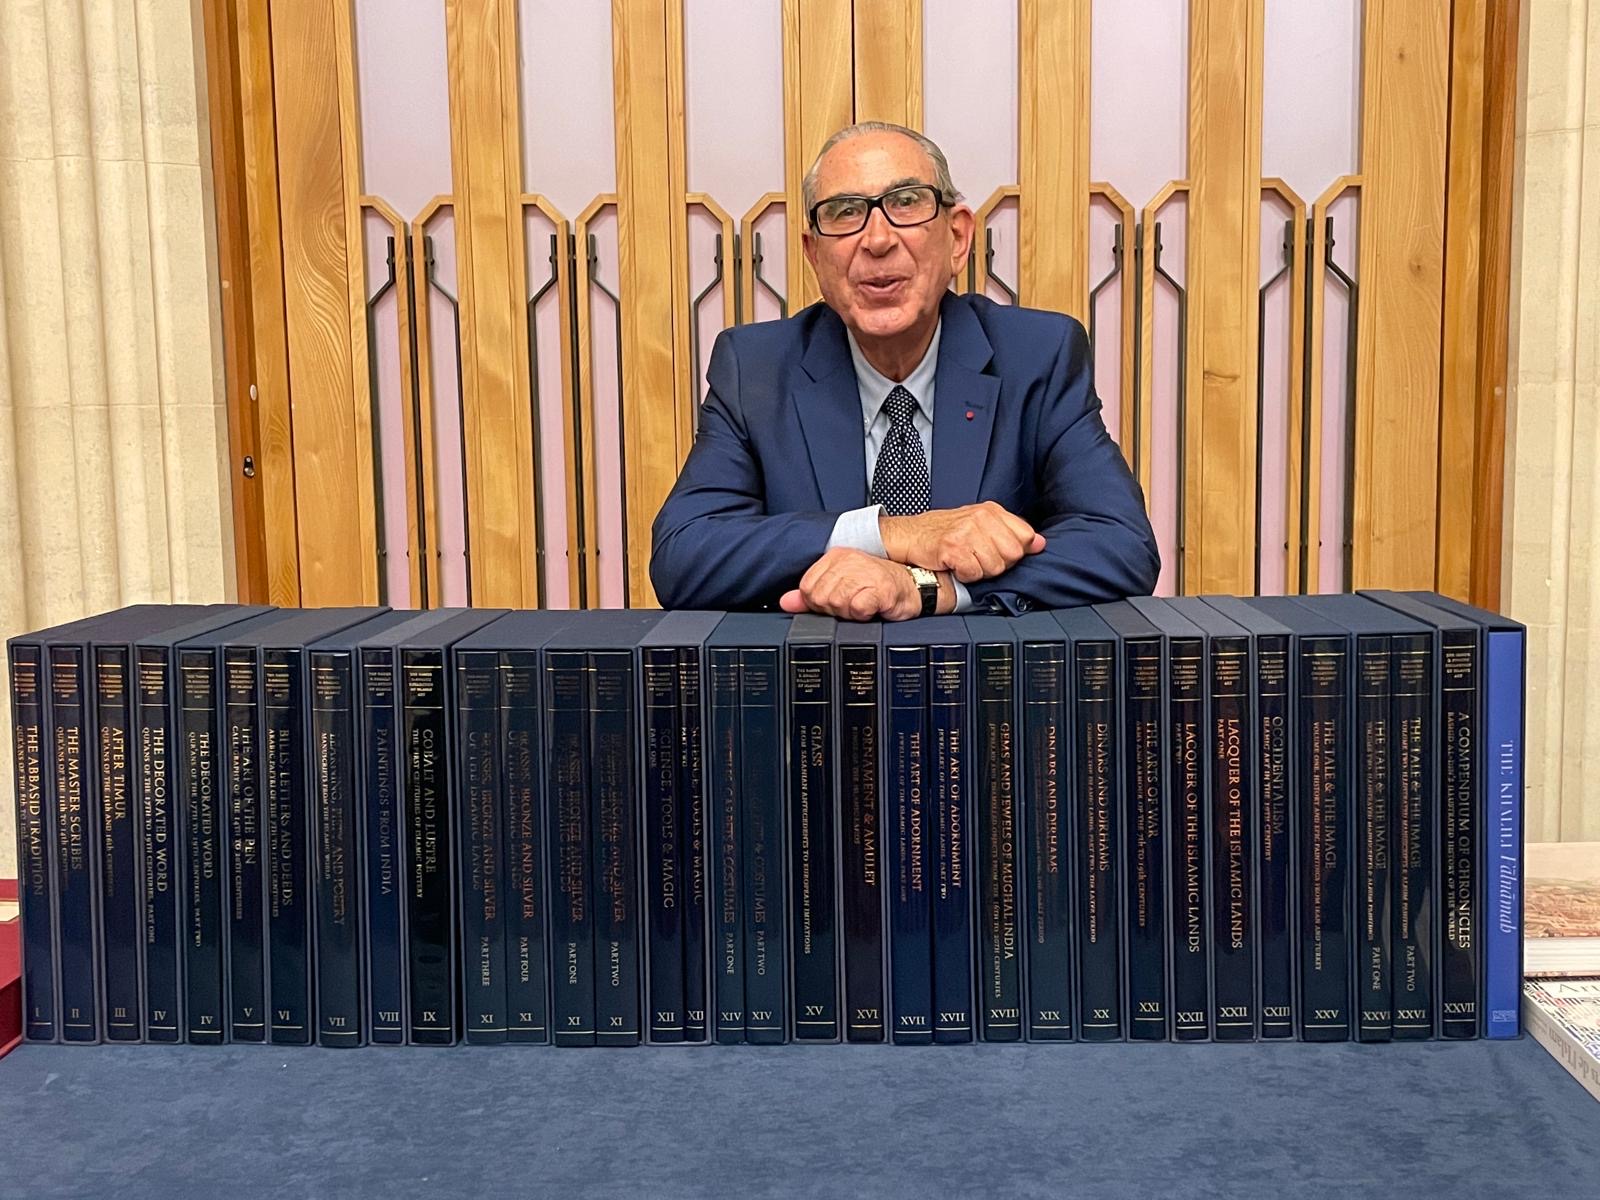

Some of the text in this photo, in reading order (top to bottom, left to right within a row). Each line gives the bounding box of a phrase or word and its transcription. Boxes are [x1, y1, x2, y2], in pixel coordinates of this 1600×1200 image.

[1410, 718, 1421, 743] THE
[811, 725, 822, 767] GLASS
[1500, 740, 1514, 776] THE
[112, 728, 125, 820] AFTER TIMUR
[1272, 716, 1284, 834] OCCIDENTALISM
[1410, 747, 1421, 777] TALE
[1146, 721, 1158, 838] THE ARTS OF WAR
[67, 727, 83, 870] THE MASTER SCRIBES
[200, 733, 213, 879] THE DECORATED WORD
[242, 728, 256, 864] THE ART OF THE PEN
[280, 773, 290, 826] LETTERS
[422, 729, 436, 873] COBALT AND LUSTRE
[861, 727, 875, 886] ORNAMENT & AMULET
[949, 729, 962, 888] THE ART OF ADORNMENT
[1096, 723, 1110, 871] DINARS AND DIRHAMS
[1324, 720, 1336, 869] THE TALE & THE IMAGE
[1410, 796, 1421, 820] THE
[27, 726, 43, 895] THE ABBASID TRADITION
[153, 728, 169, 891] THE DECORATED WORD
[377, 729, 392, 895] PAINTINGS FROM INDIA
[415, 817, 421, 828] OF
[660, 728, 674, 908] SCIENCE, TOOLS & MAGIC
[909, 732, 922, 891] THE ART OF ADORNMENT
[1499, 783, 1514, 848] KHALILI
[281, 830, 292, 858] AND
[1000, 723, 1014, 959] GEMS AND JEWELS OF MUGHAL INDIA
[1184, 723, 1200, 953] LACQUER OF THE ISLAMIC LANDS
[1227, 719, 1243, 949] LACQUER OF THE ISLAMIC LANDS
[1458, 713, 1471, 949] A COMPENDIUM OF CHRONICLES
[1409, 824, 1421, 868] IMAGE
[282, 863, 294, 906] DEEDS
[480, 936, 489, 986] PART THREE
[520, 937, 529, 983] PART FOUR
[569, 942, 577, 964] PART
[610, 941, 619, 987] PART TWO
[726, 933, 734, 975] PART ONE
[756, 930, 765, 976] PART TWO
[1372, 947, 1381, 990] PART ONE
[1406, 945, 1415, 992] PART TWO
[114, 1008, 126, 1017] III
[153, 1011, 164, 1021] IV
[200, 1016, 213, 1025] IV
[243, 1008, 253, 1017] V
[278, 1011, 289, 1021] VI
[378, 1012, 399, 1022] VIII
[424, 1011, 436, 1021] IX
[481, 1015, 493, 1024] XI
[520, 1012, 532, 1022] XI
[568, 1016, 580, 1025] XI
[610, 1016, 622, 1026] XI
[657, 1012, 674, 1022] XII
[688, 1011, 704, 1020] XII
[721, 1012, 742, 1021] XIV
[752, 1011, 772, 1020] XIV
[805, 1005, 824, 1016] XV
[857, 1009, 879, 1019] XVI
[901, 1016, 925, 1025] XVII
[940, 1013, 966, 1022] XVII
[990, 1008, 1019, 1018] XVIII
[1039, 1011, 1060, 1020] XIX
[1093, 1009, 1109, 1018] XX
[1139, 1002, 1159, 1012] XXI
[1177, 1012, 1203, 1022] XXII
[1220, 1006, 1247, 1017] XXII
[1314, 1009, 1339, 1019] XXV
[1361, 1011, 1391, 1020] XXVI
[1397, 1010, 1426, 1019] XXVI
[1444, 1003, 1474, 1013] XXVII
[329, 1017, 344, 1026] VII
